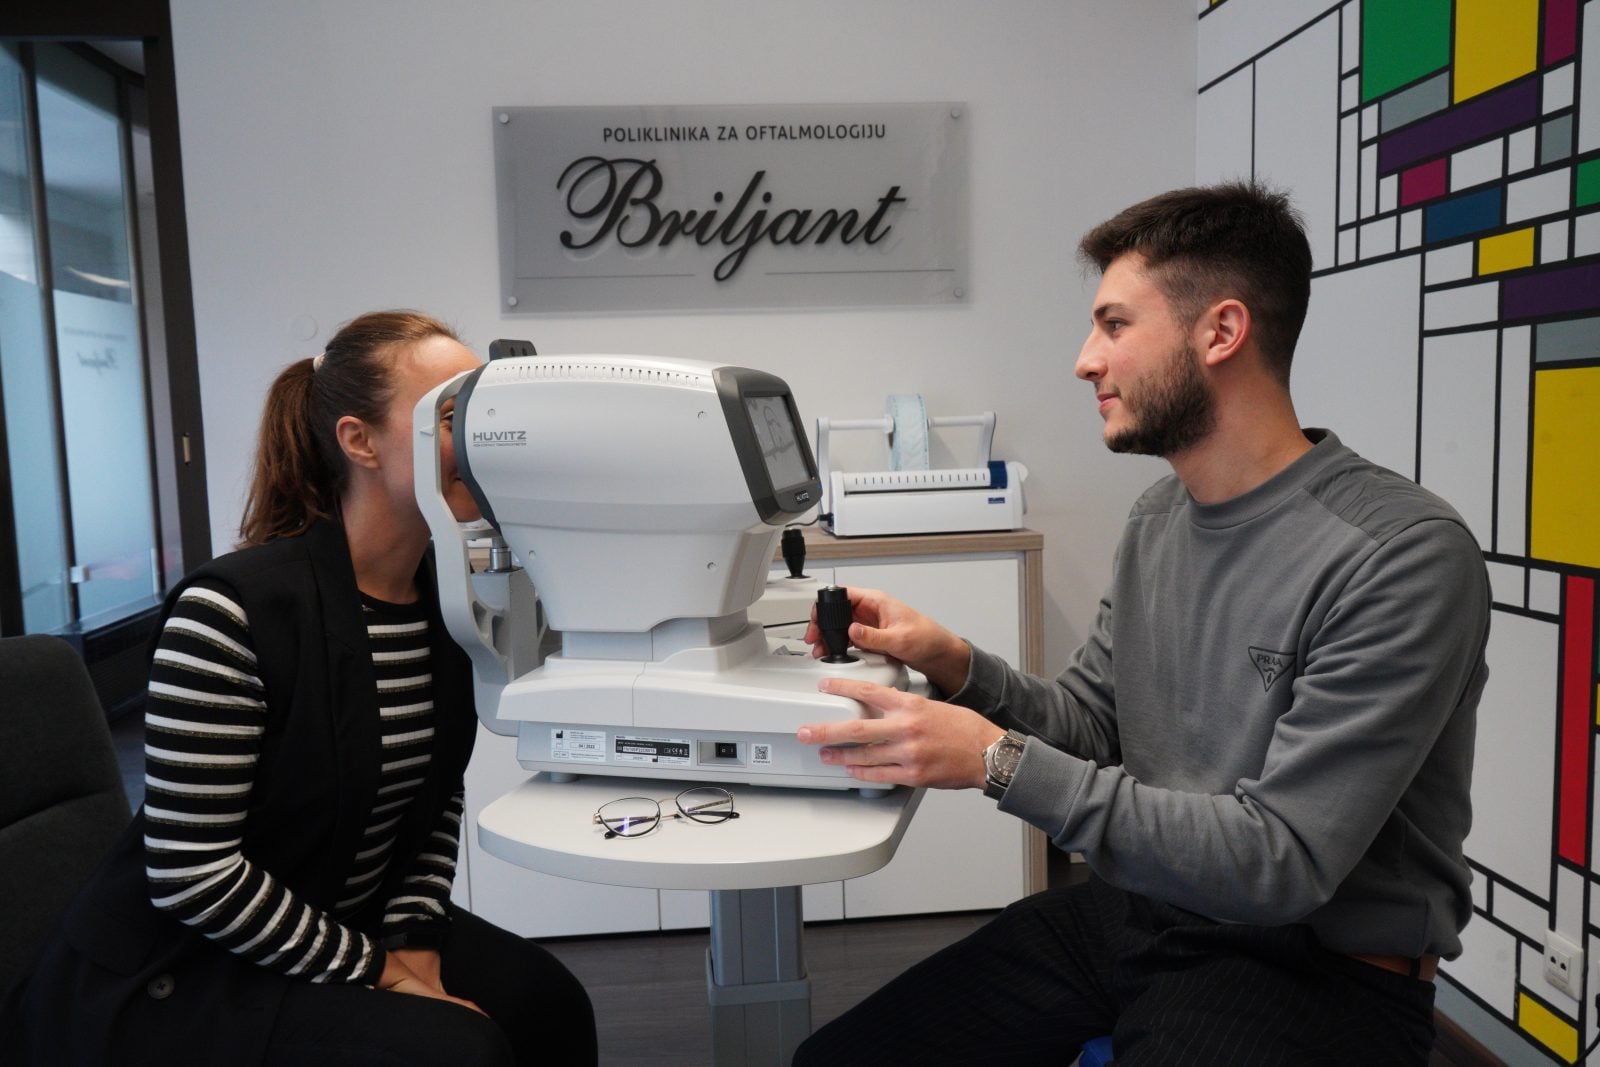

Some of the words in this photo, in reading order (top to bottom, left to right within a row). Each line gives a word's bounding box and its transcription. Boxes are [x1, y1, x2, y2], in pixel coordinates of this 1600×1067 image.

[603, 126, 709, 142] POLIKLINIKA
[717, 125, 738, 141] ZA
[746, 124, 886, 140] OFTALMOLOGIJU
[556, 156, 906, 281] Briljant
[472, 430, 527, 441] HUVITZ
